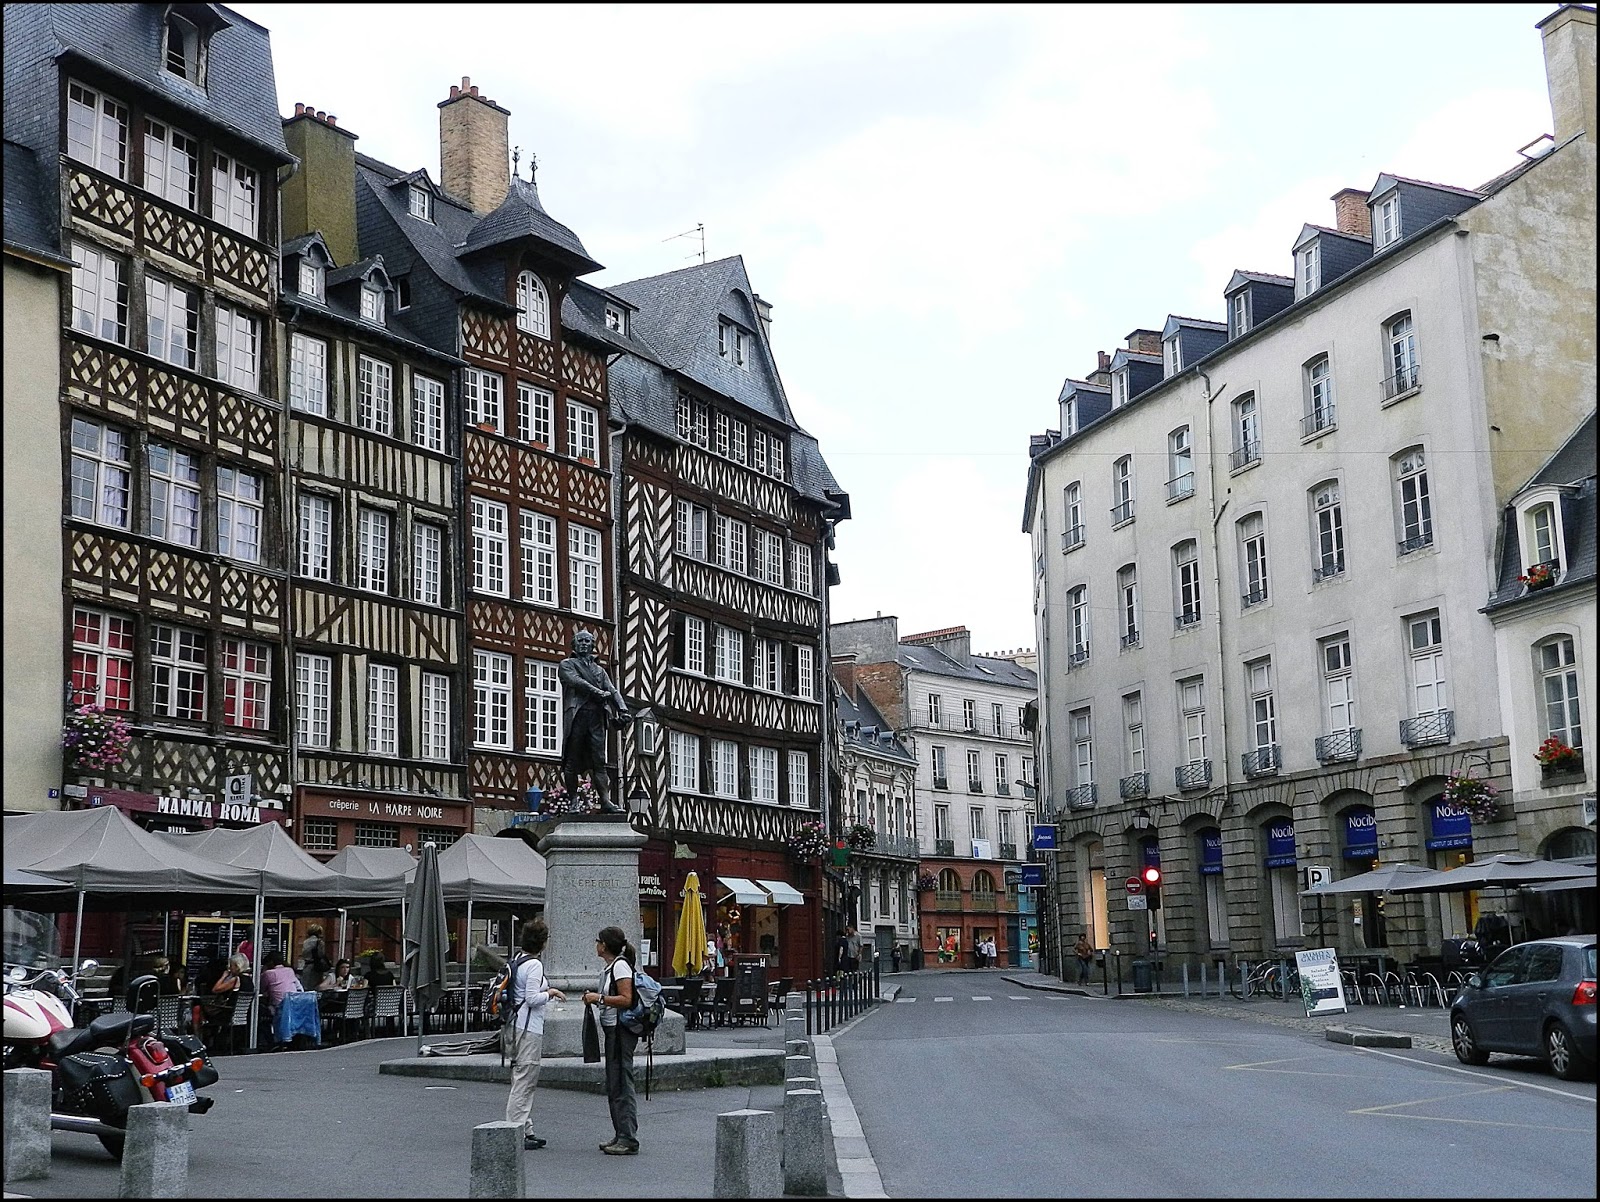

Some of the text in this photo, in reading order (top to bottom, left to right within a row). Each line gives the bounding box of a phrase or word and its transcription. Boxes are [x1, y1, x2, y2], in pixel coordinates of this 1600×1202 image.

[52, 789, 58, 797] 9
[158, 796, 261, 823] MAMMA ROMA
[329, 799, 443, 819] crêperie LA HARPE NOIRE
[1436, 804, 1472, 818] Nocib
[1311, 870, 1323, 884] P
